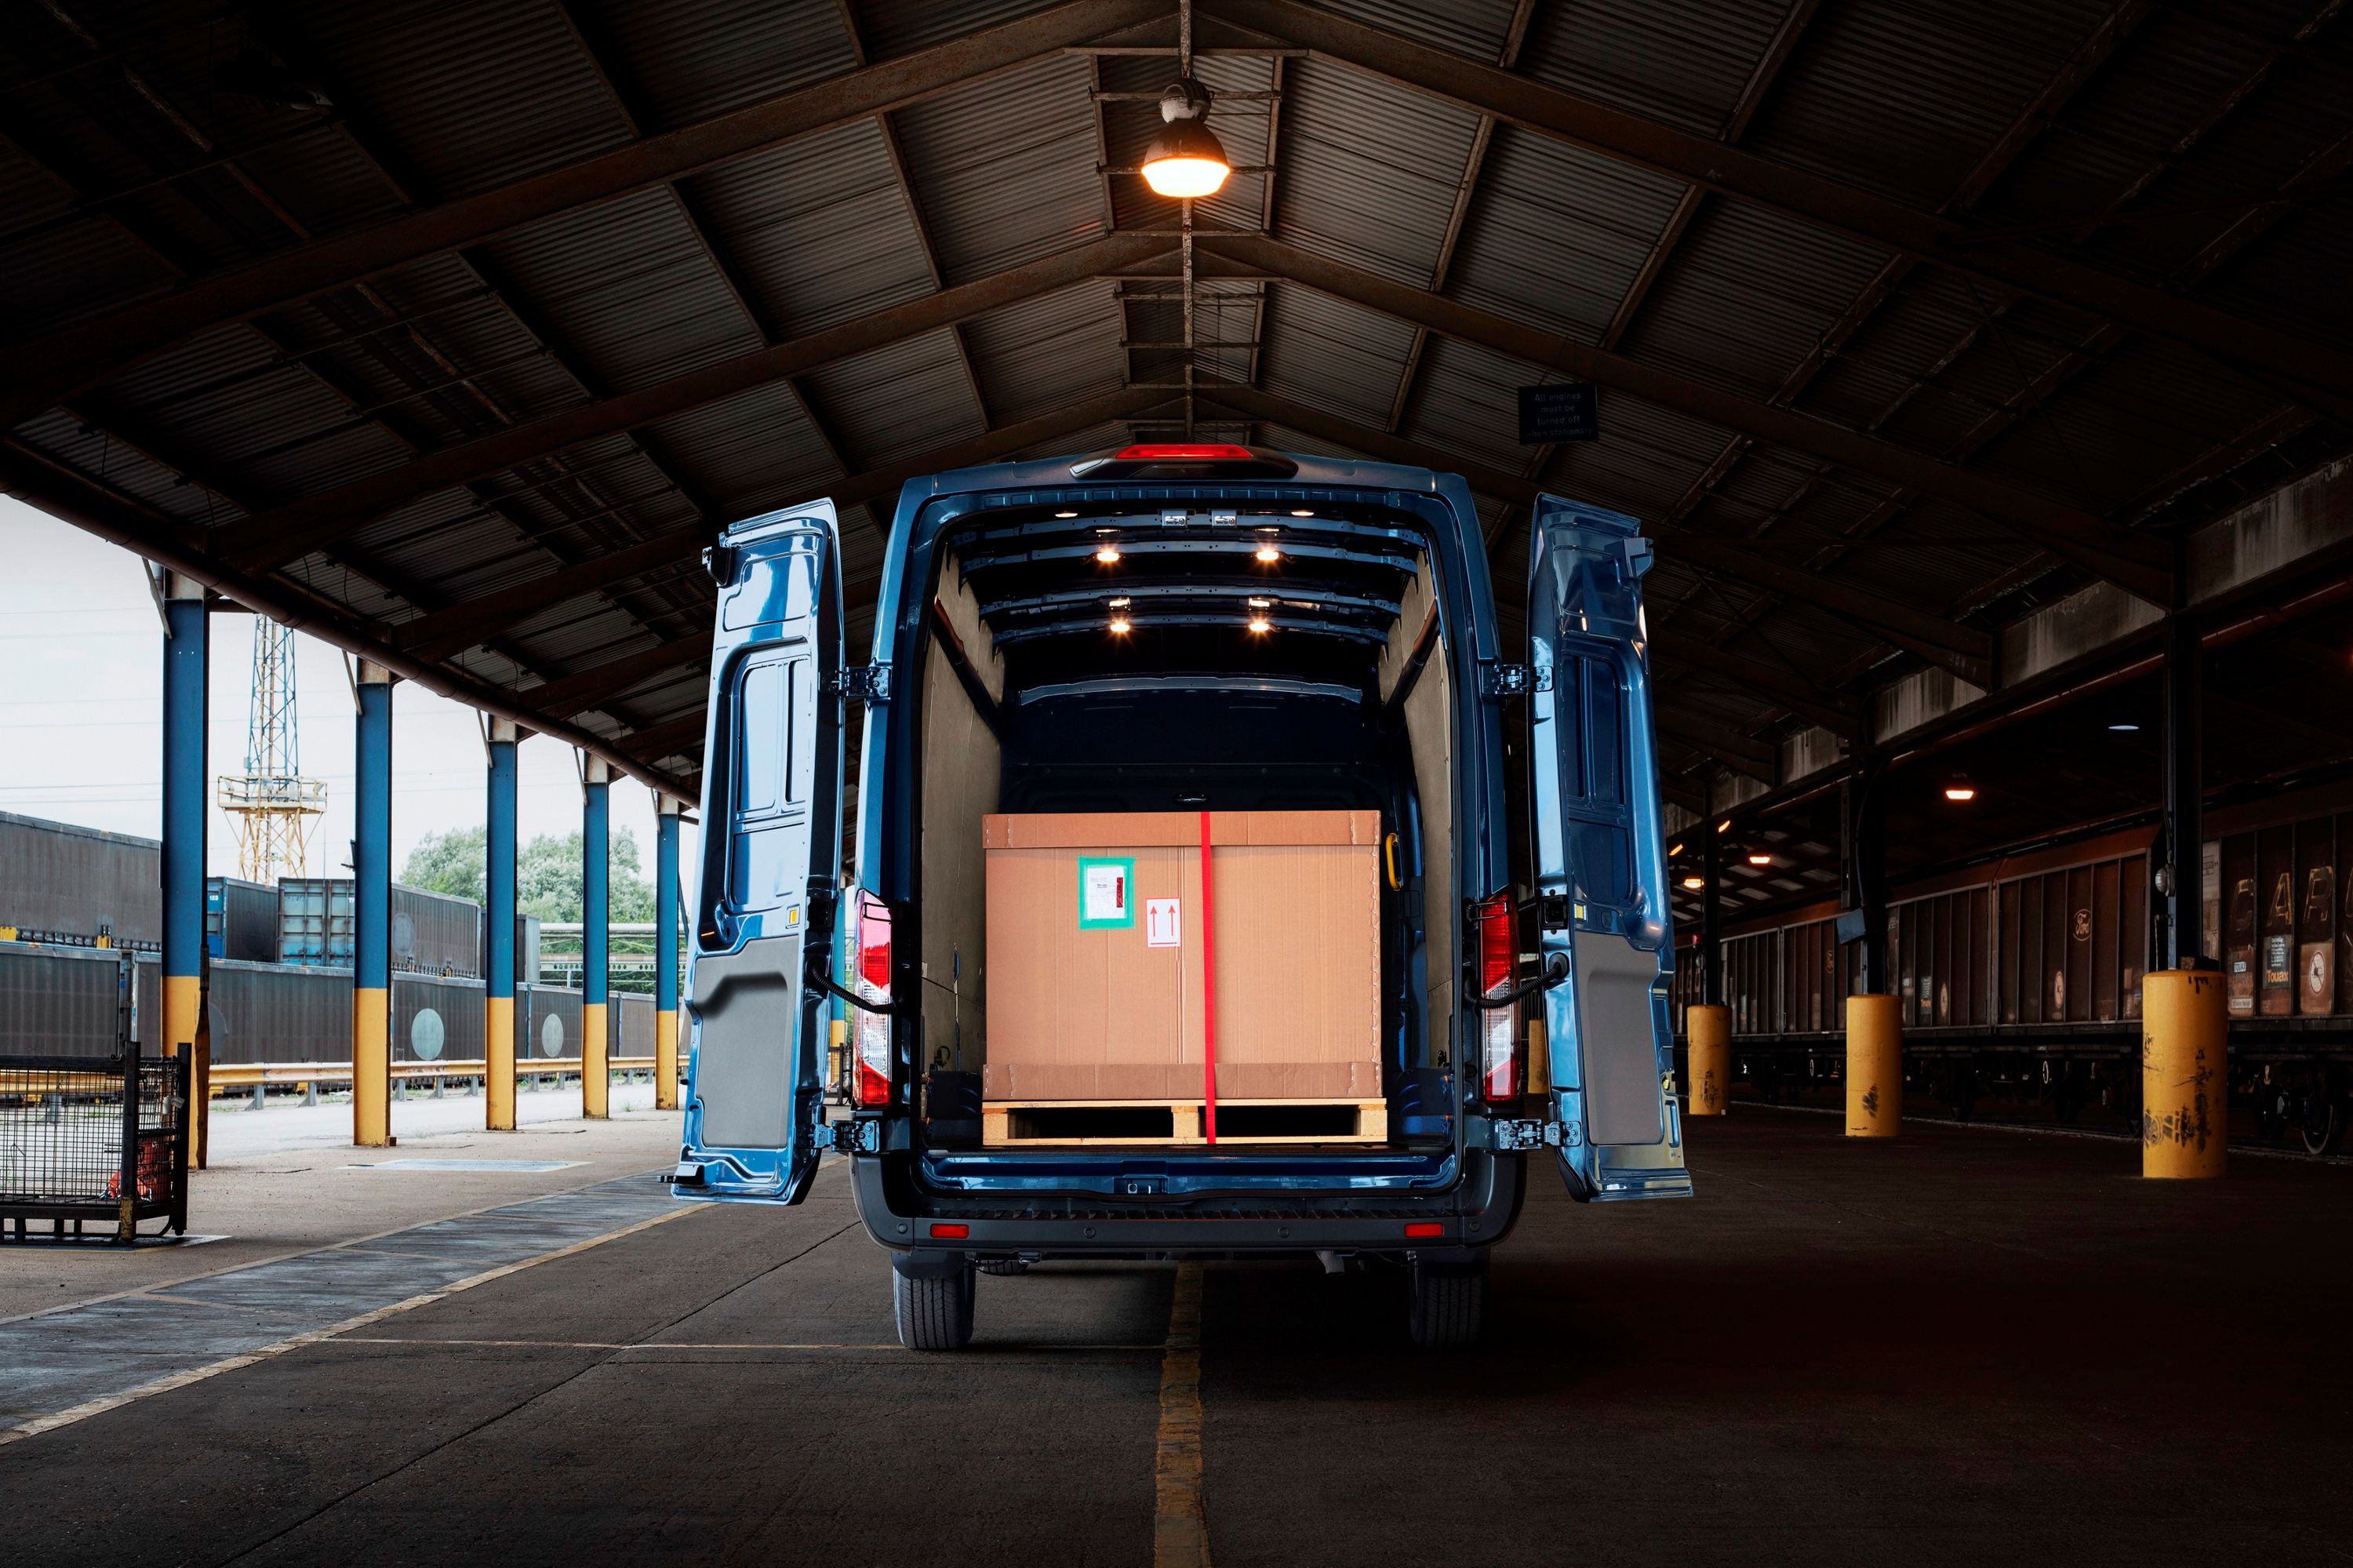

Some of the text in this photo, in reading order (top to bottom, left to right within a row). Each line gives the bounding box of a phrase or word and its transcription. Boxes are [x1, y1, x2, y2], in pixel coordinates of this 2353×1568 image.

[1534, 392, 1581, 402] All engines
[1537, 415, 1580, 426] turned off
[1526, 427, 1594, 438] when stationary
[2231, 865, 2353, 932] CAR
[2267, 969, 2289, 983] Touax
